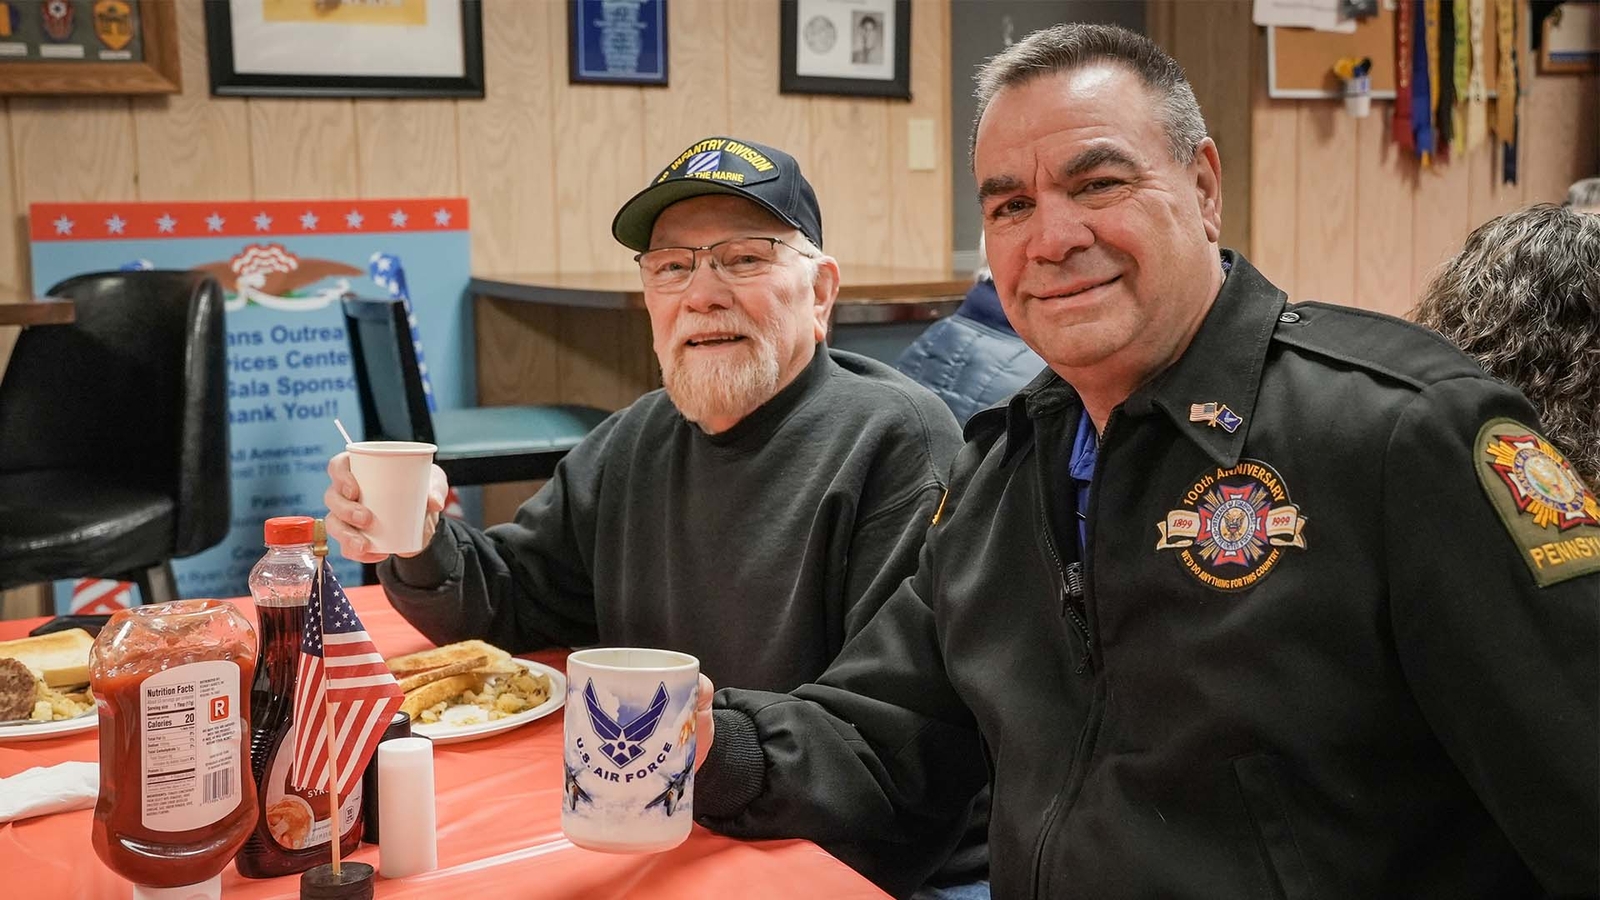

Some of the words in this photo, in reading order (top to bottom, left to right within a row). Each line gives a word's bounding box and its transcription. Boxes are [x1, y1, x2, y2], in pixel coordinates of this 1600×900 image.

[670, 140, 726, 171] INFANTRY
[724, 140, 774, 173] DIVISION
[695, 171, 712, 179] THE
[712, 171, 745, 184] MARNE
[283, 399, 339, 419] You!!
[1183, 475, 1215, 507] 100th
[1172, 518, 1194, 529] 1899
[1271, 516, 1292, 527] 1999
[1190, 564, 1202, 576] DO
[1198, 570, 1231, 590] ANYTHING
[1230, 578, 1244, 590] FOR
[1242, 571, 1258, 587] THIS
[1255, 547, 1281, 578] COUNTRY
[147, 687, 176, 698] Nutrition
[177, 684, 195, 694] Facts
[214, 700, 226, 718] R
[147, 719, 173, 729] Calories
[185, 712, 195, 724] 20
[575, 736, 592, 769] U.S.
[593, 767, 621, 784] AIR
[624, 741, 673, 784] FORCE
